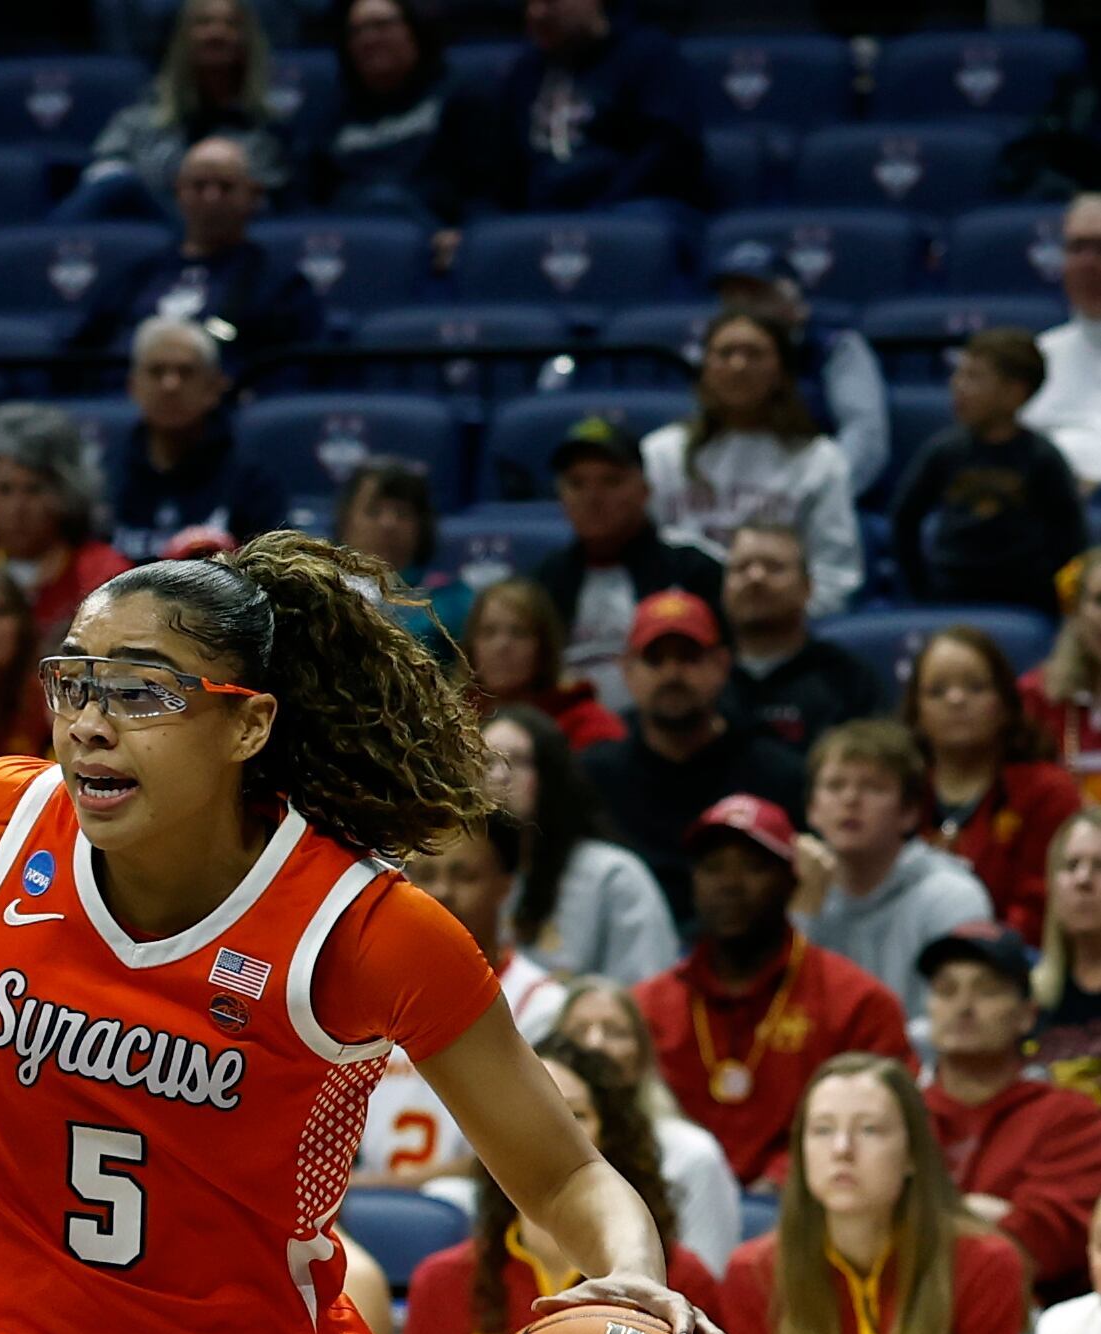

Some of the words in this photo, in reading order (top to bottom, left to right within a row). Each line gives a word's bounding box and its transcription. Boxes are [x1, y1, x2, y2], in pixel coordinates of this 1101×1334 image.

[25, 867, 51, 887] NCAA
[390, 1109, 438, 1170] 2
[66, 1121, 145, 1268] 5
